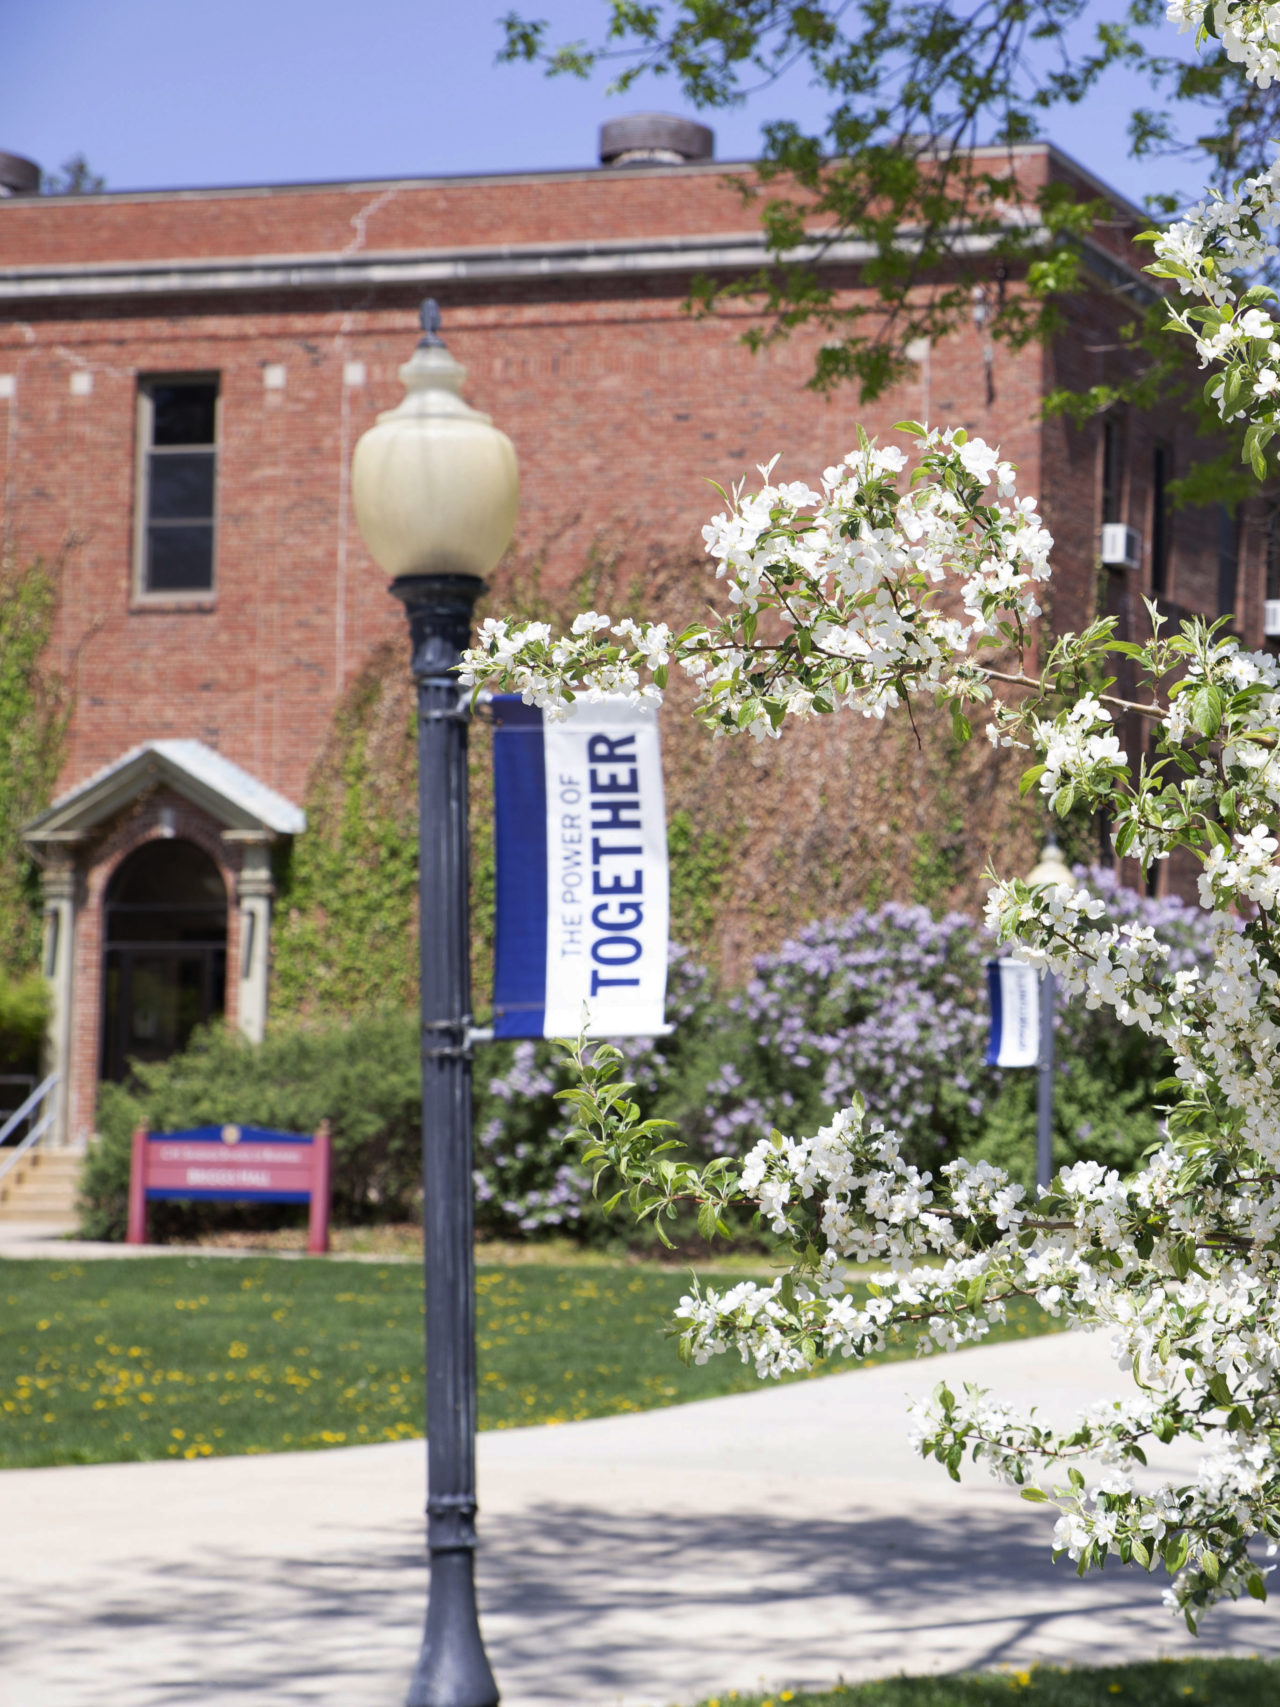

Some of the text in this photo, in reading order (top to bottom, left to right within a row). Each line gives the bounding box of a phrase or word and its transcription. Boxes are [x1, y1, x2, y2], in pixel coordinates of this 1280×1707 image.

[559, 773, 583, 958] THE POWER OF
[587, 732, 644, 998] TOGETHER
